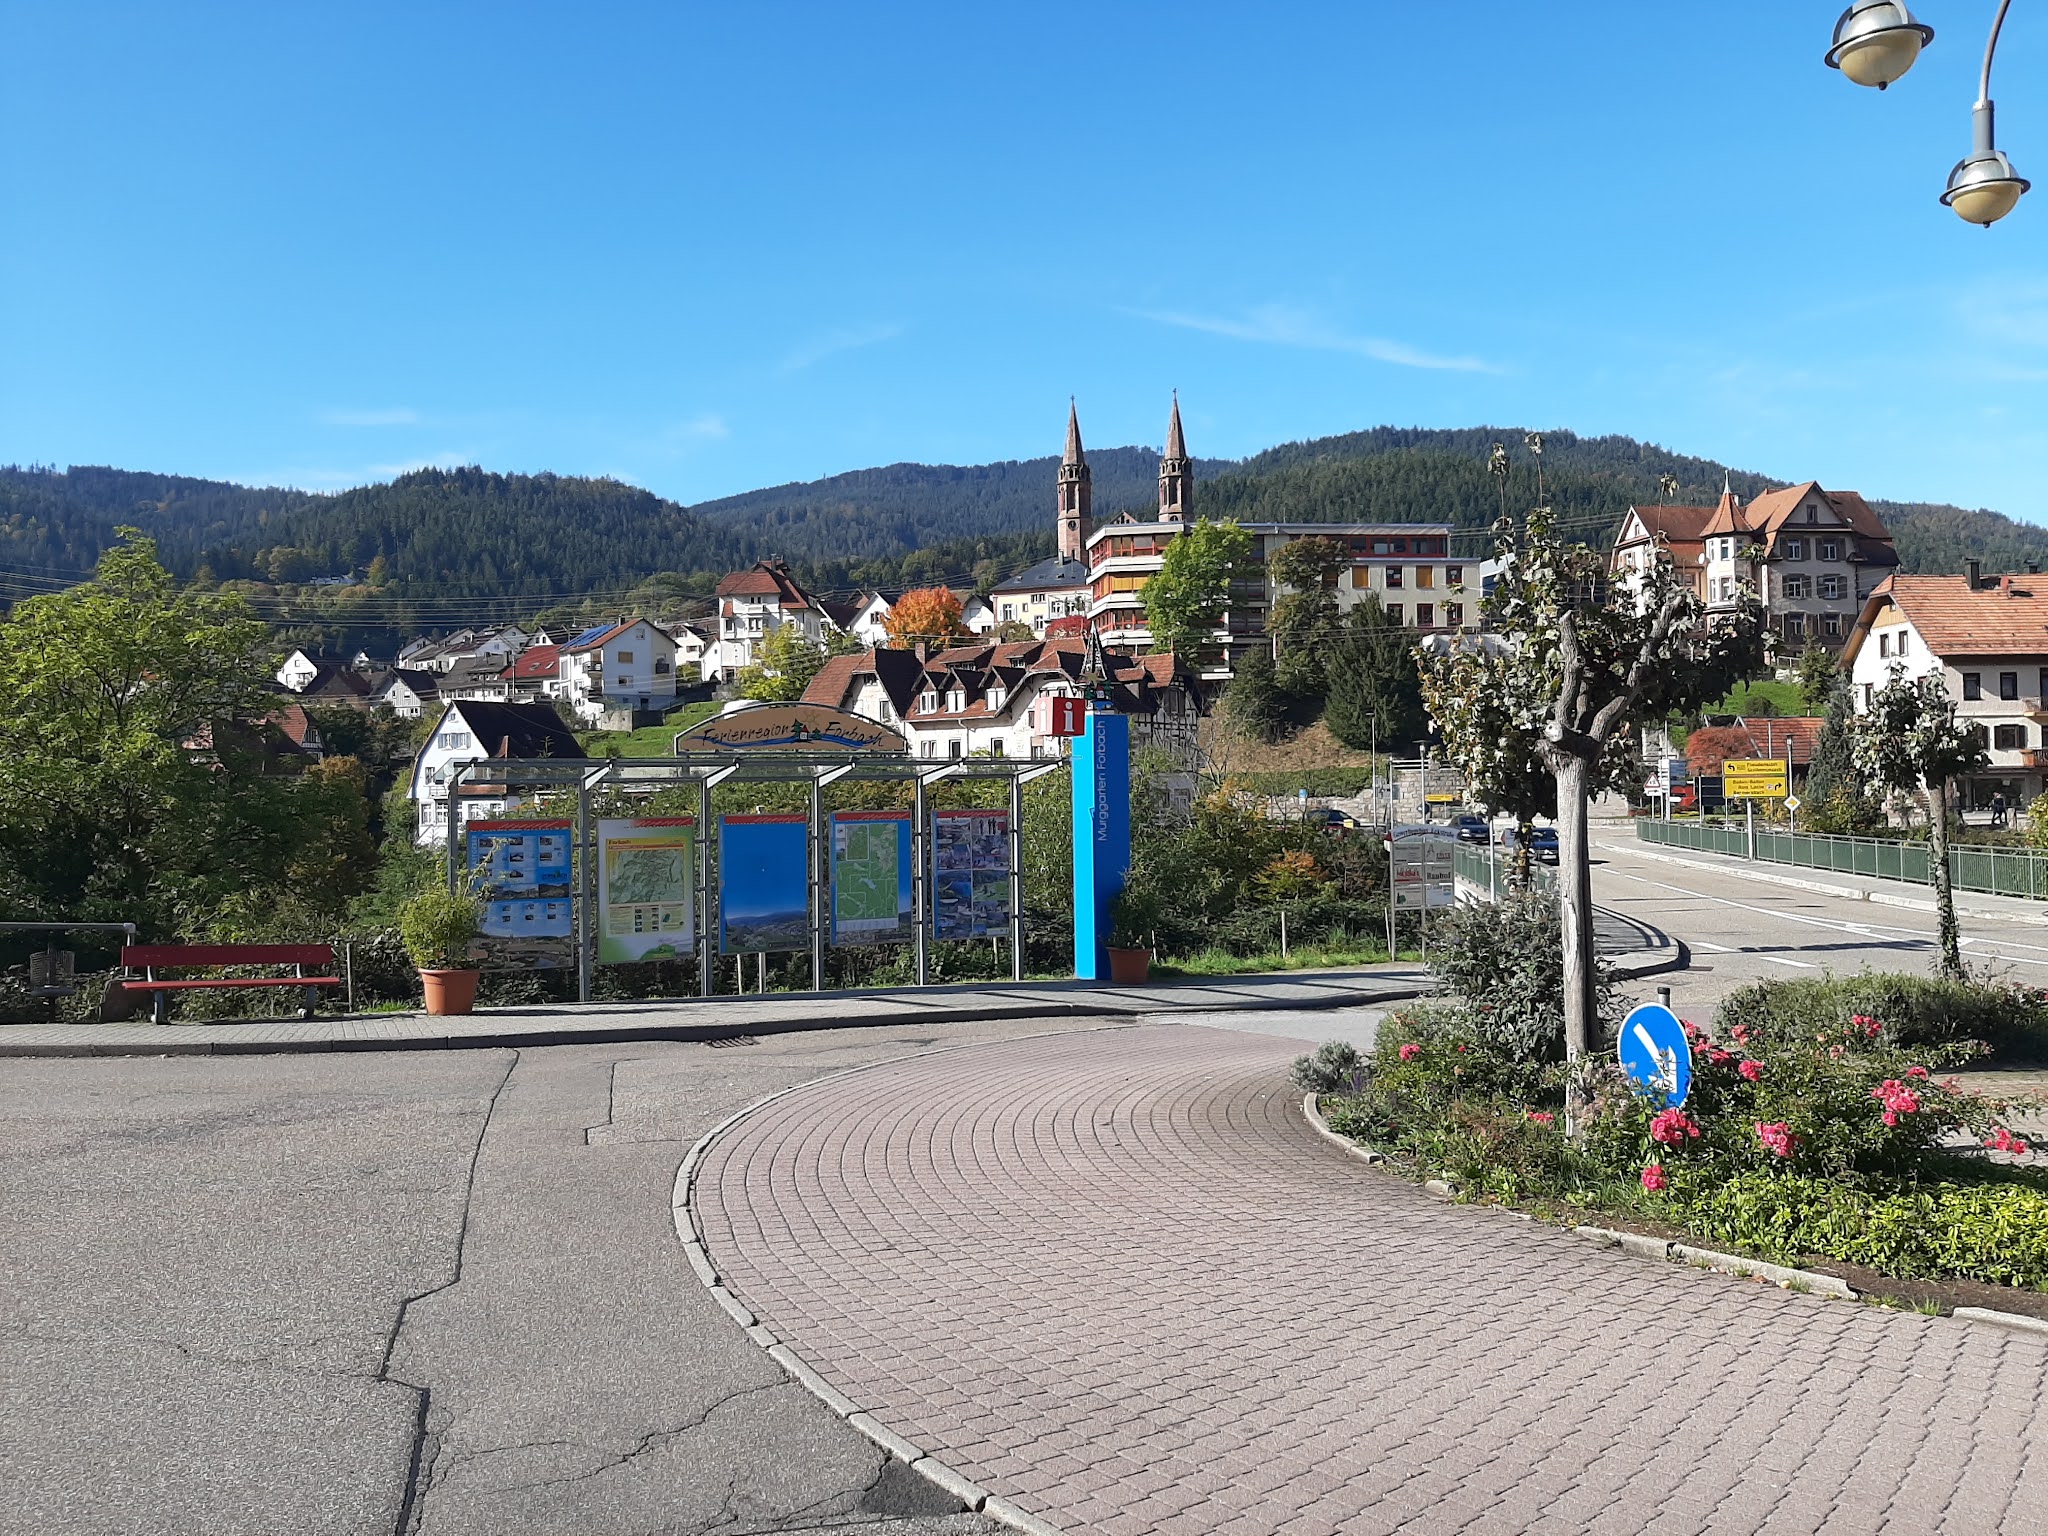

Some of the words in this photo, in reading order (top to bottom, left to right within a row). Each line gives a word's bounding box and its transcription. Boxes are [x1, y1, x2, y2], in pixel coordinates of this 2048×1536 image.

[702, 725, 789, 745] Ferienregion
[825, 721, 884, 747] Forbach
[1063, 701, 1075, 732] i
[1096, 720, 1106, 770] Forbach
[1097, 773, 1109, 841] Murggarten
